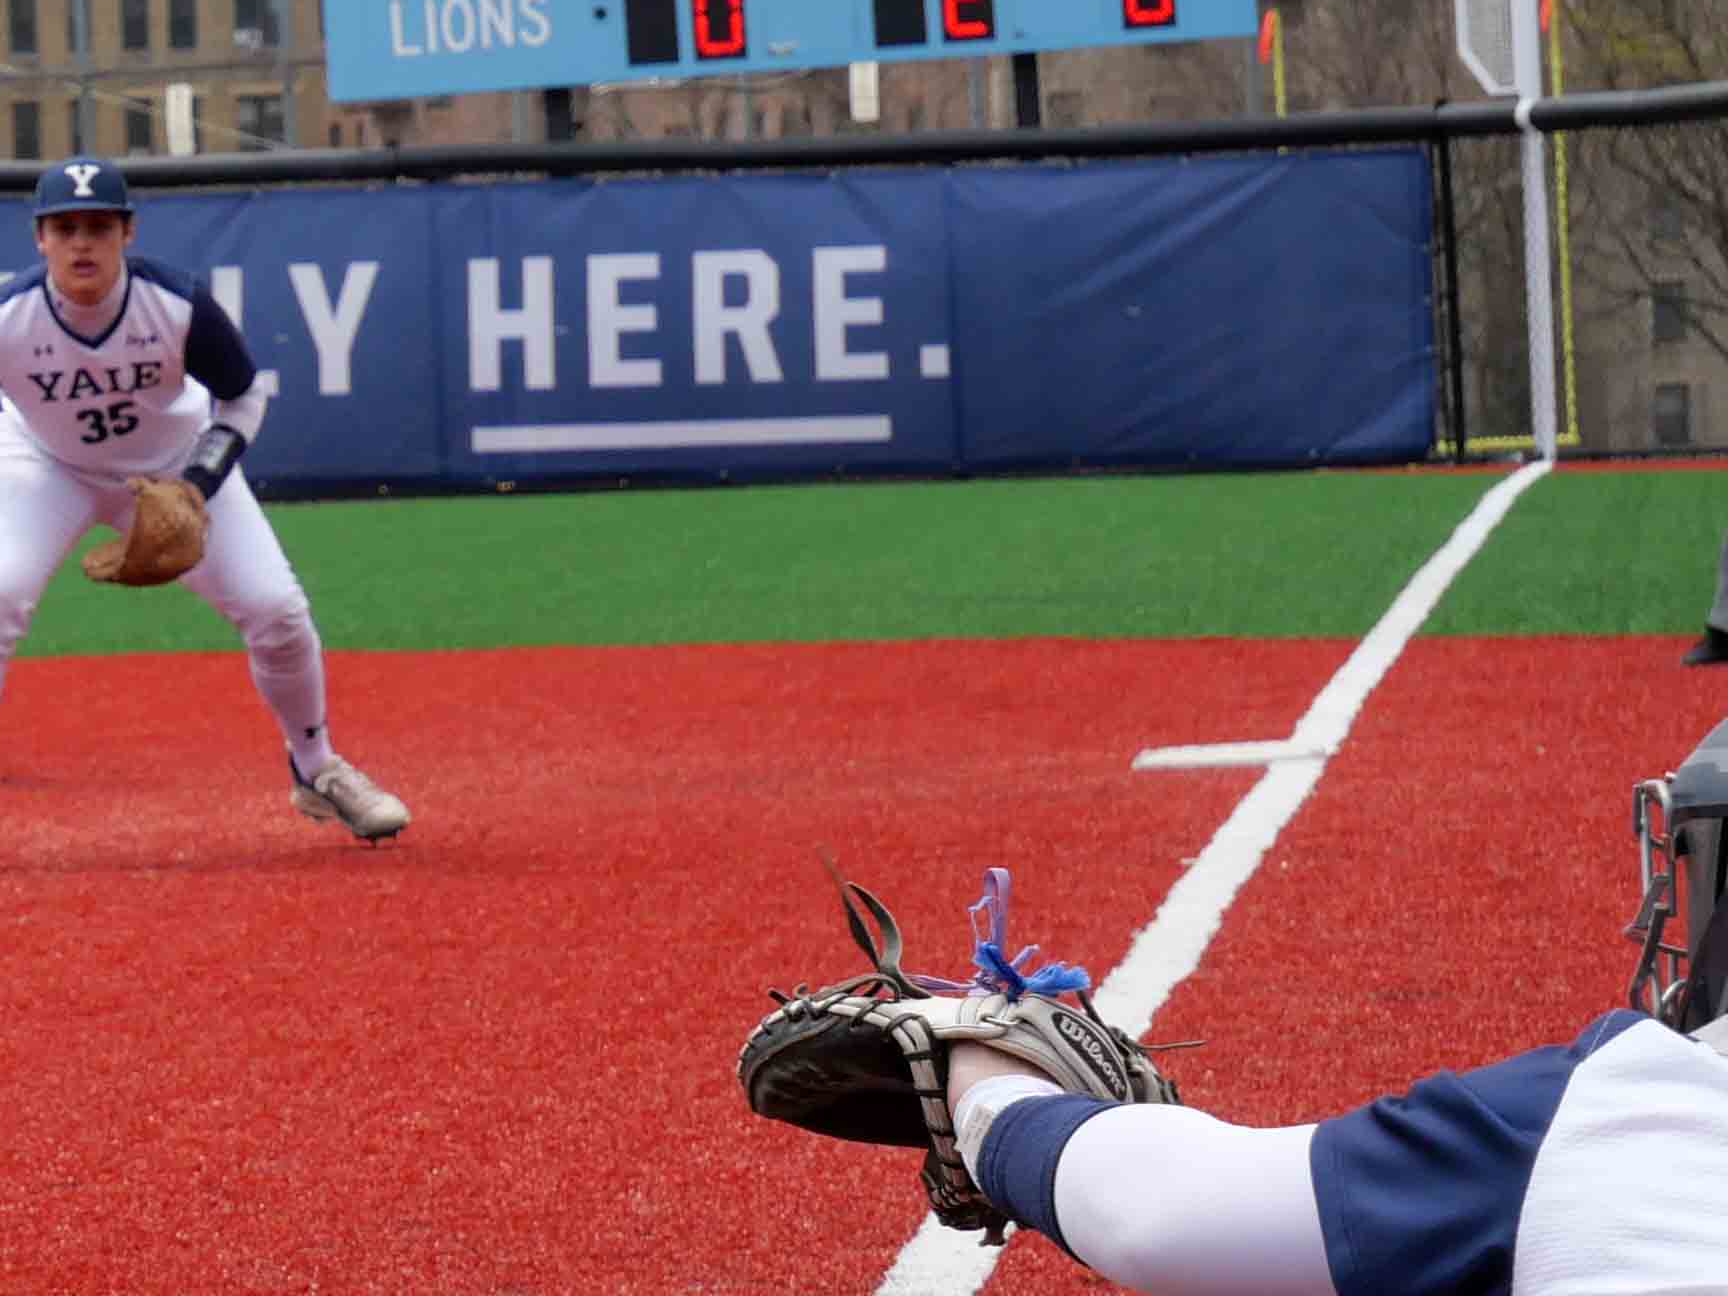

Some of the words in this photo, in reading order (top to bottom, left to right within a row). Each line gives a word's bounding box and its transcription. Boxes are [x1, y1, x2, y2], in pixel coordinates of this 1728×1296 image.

[63, 164, 101, 197] Y
[467, 244, 951, 392] HERE.
[27, 361, 163, 402] YALE
[76, 401, 140, 446] 35
[1059, 1014, 1126, 1094] Wilson
